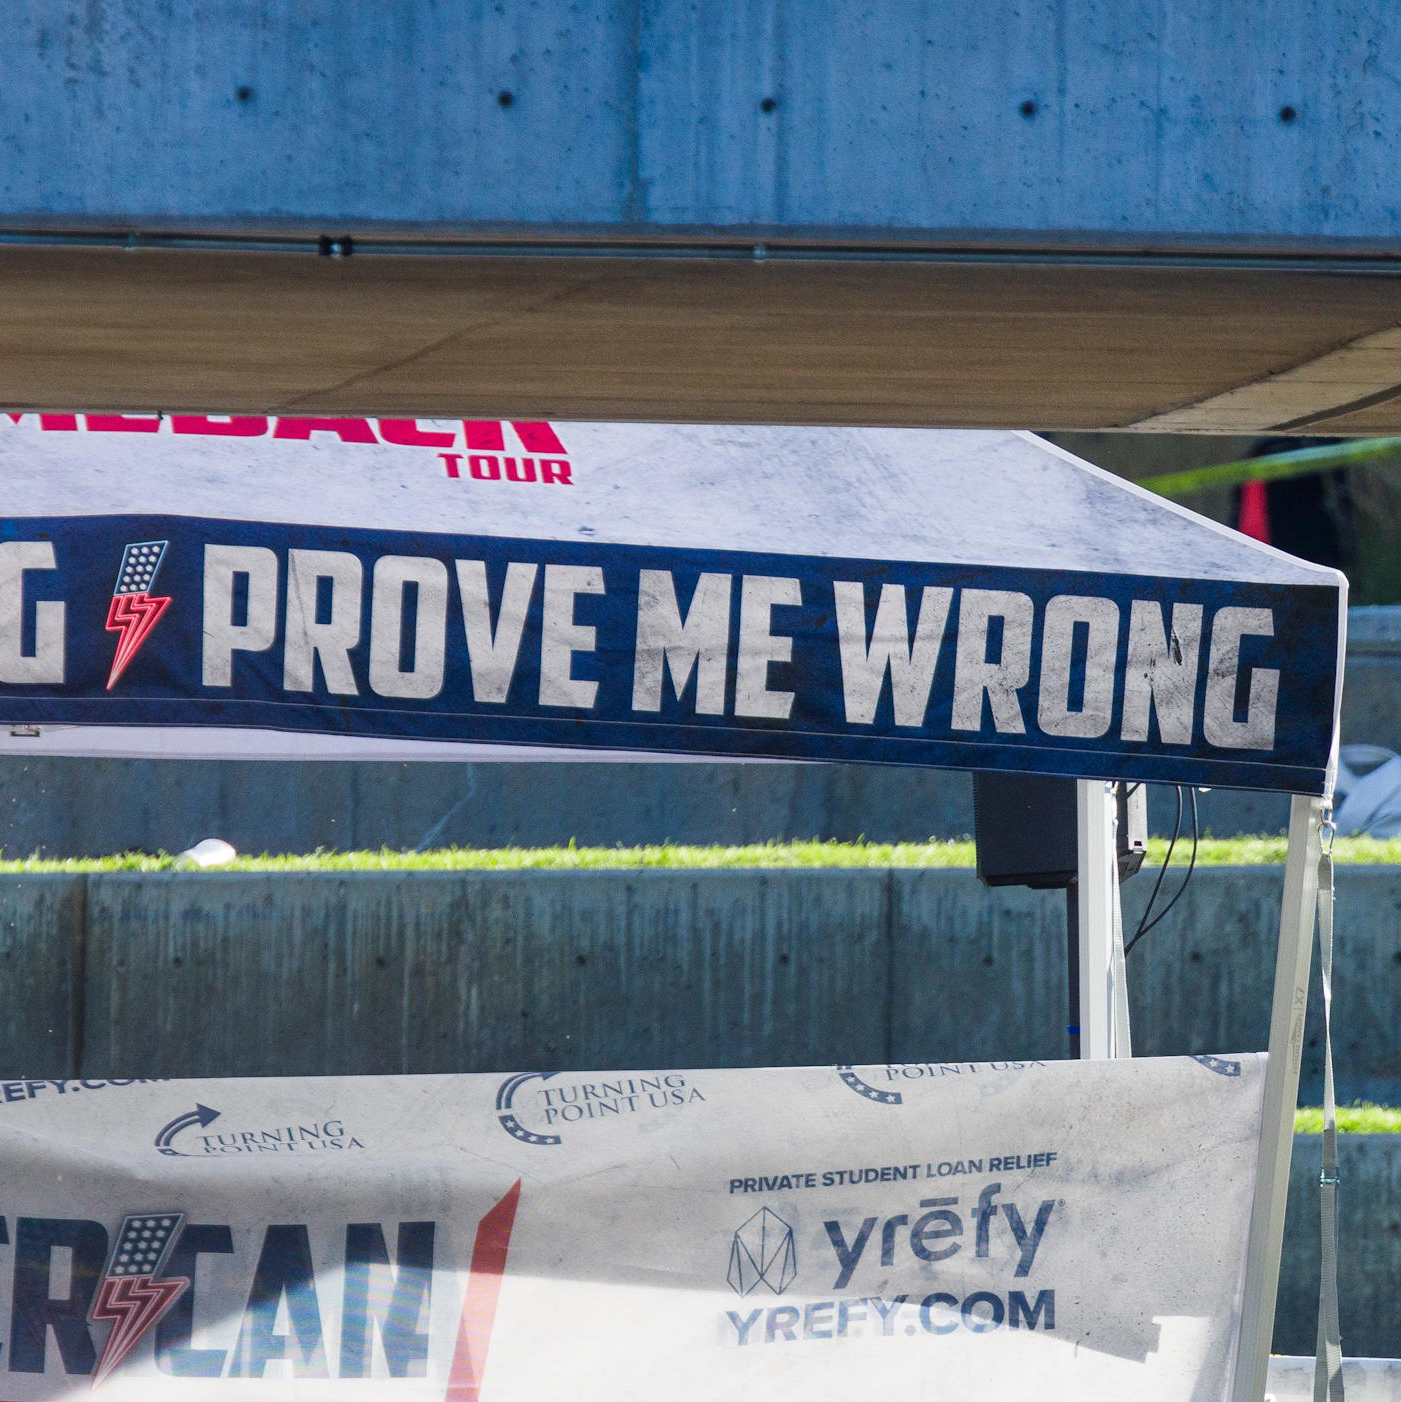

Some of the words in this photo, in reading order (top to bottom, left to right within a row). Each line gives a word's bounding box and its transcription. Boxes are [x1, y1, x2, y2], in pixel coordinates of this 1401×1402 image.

[439, 453, 574, 486] TOUR
[202, 543, 605, 709] PROVE
[632, 569, 803, 719] ME
[834, 581, 1279, 751] WRONG
[538, 1073, 687, 1106] TURNING
[544, 1095, 641, 1125] POINT
[649, 1087, 706, 1109] USA
[198, 1142, 303, 1154] POINT
[307, 1136, 365, 1151] USA
[200, 1120, 346, 1147] TURNING
[729, 1173, 817, 1194] PRIVATE
[821, 1164, 921, 1189] STUDENT
[926, 1158, 984, 1179] LOAN
[988, 1151, 1058, 1172] RELIEF
[725, 1290, 1056, 1346] YREFY.COM
